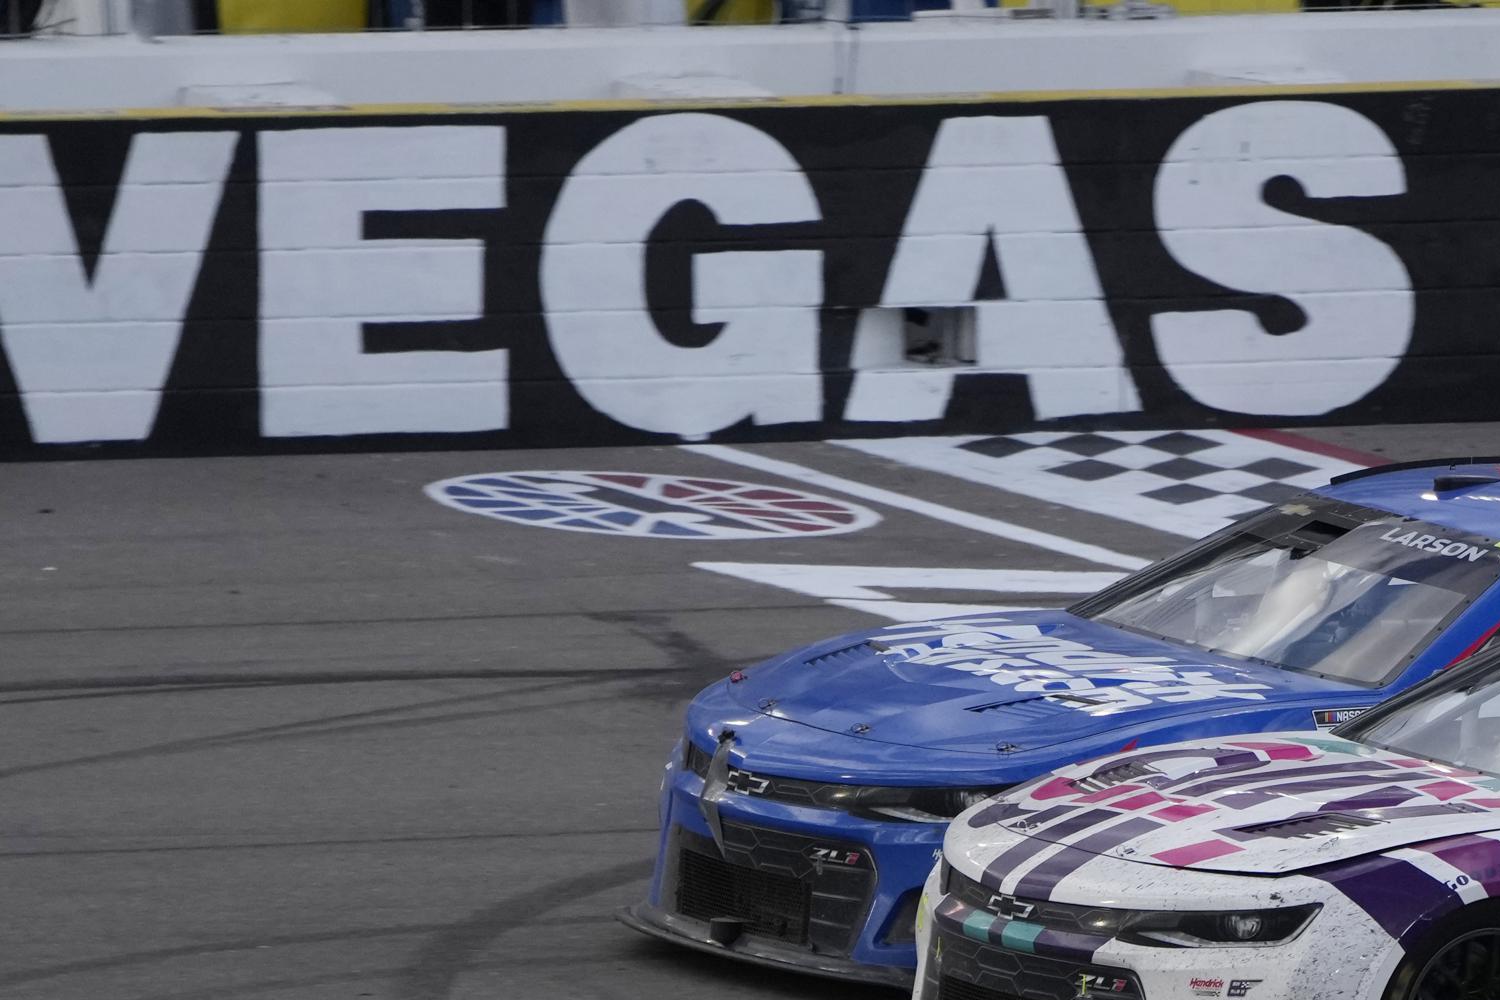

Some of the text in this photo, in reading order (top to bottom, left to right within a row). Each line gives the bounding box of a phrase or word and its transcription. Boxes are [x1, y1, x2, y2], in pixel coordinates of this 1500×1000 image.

[0, 99, 1415, 443] VEGAS
[1379, 527, 1489, 562] LARSON
[1189, 977, 1225, 990] Hendrick
